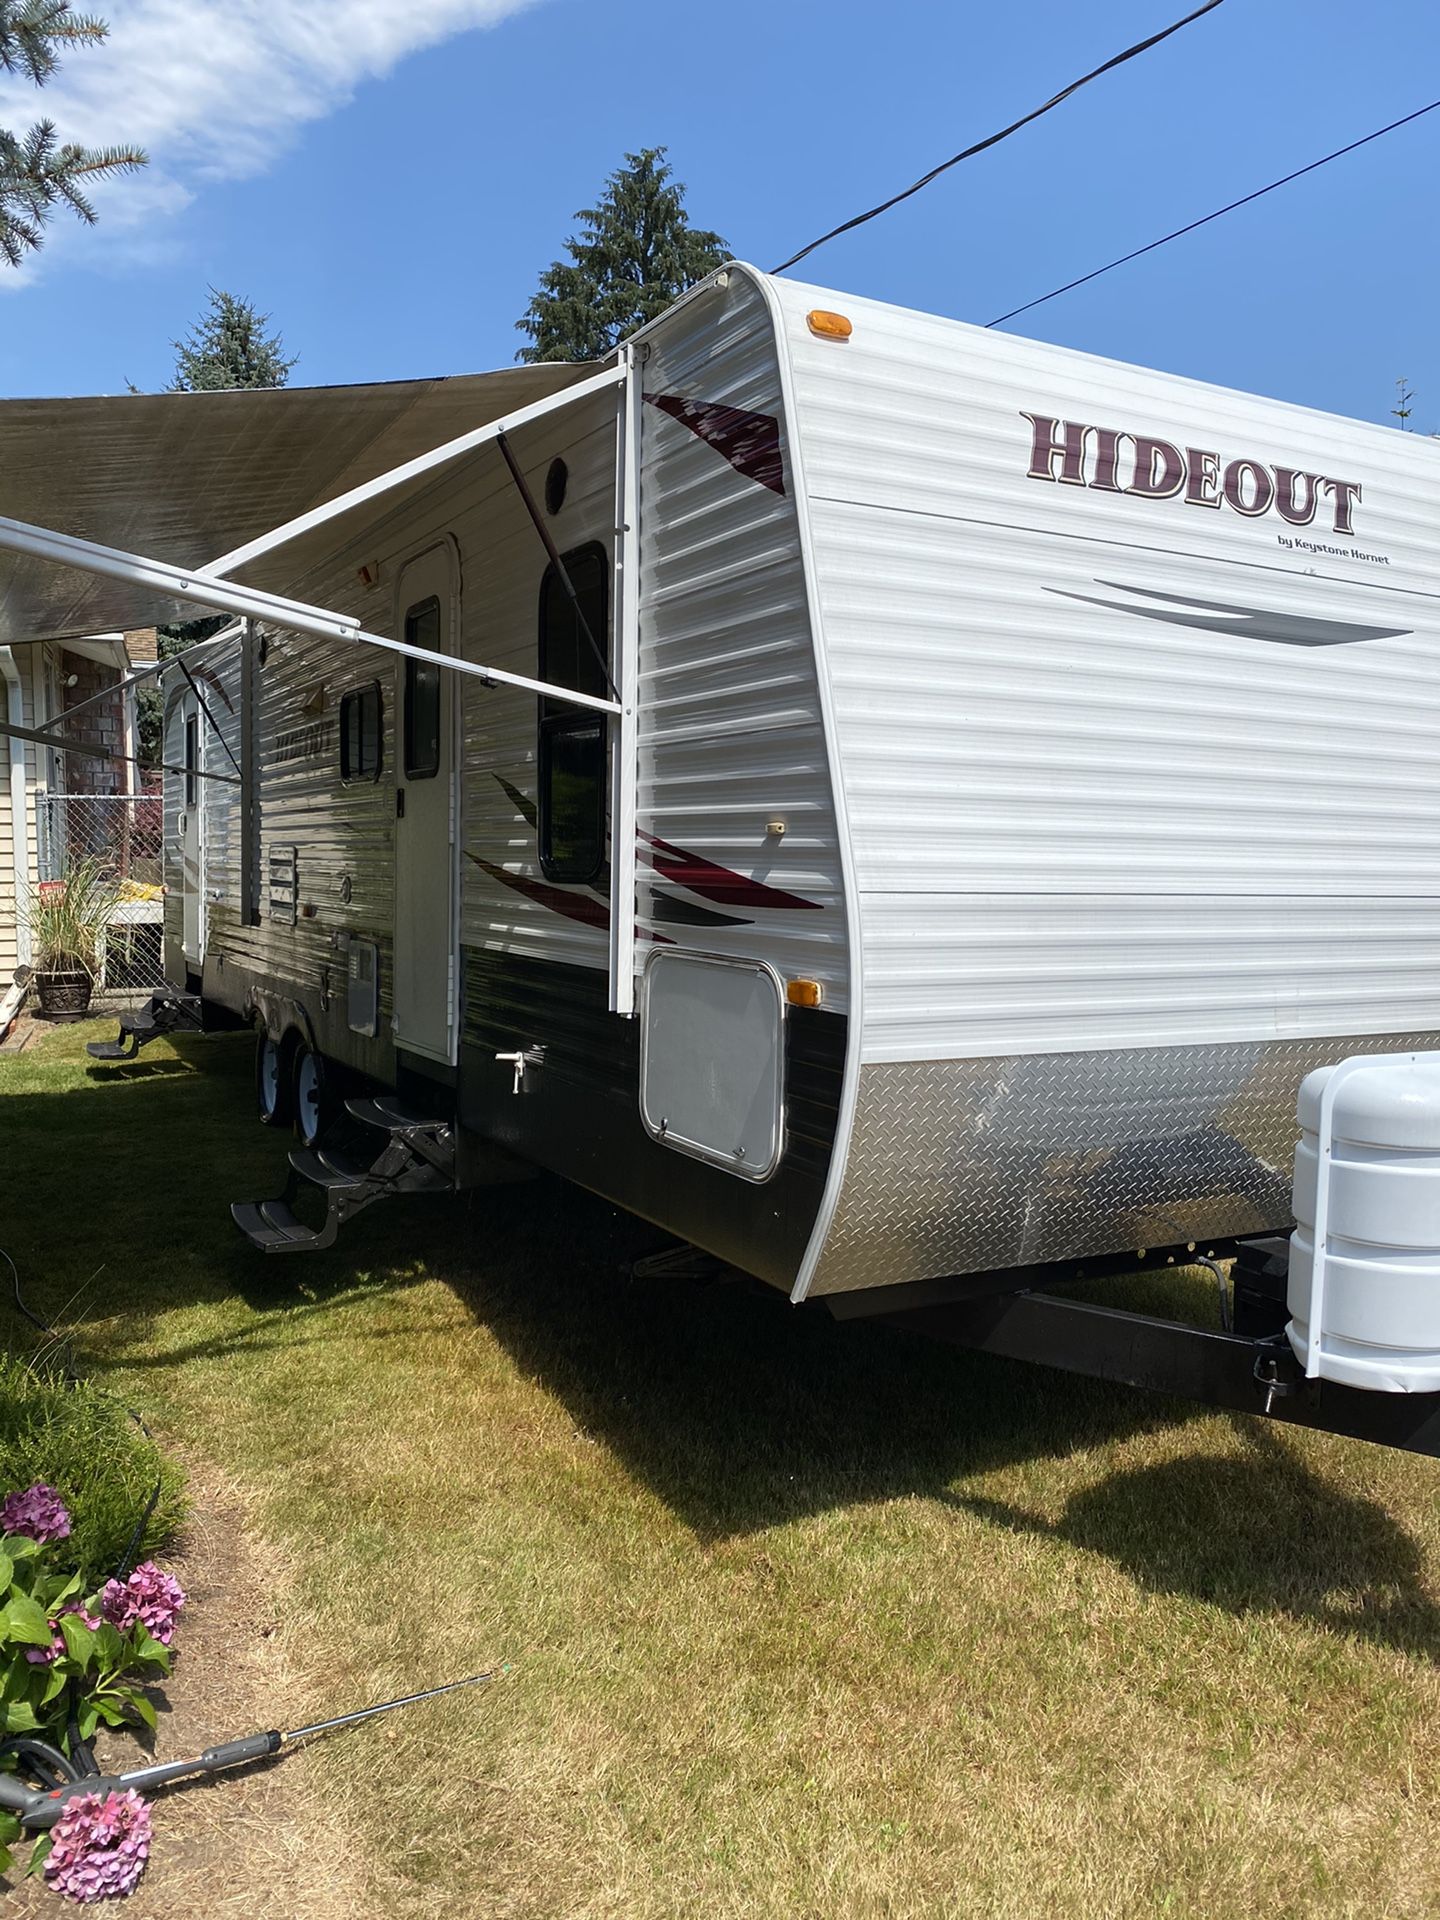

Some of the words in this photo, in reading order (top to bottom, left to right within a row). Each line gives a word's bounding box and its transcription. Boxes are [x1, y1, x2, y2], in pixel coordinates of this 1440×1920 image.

[1019, 411, 1362, 535] HIDEOUT
[1277, 535, 1293, 549] by
[1294, 538, 1350, 557] Keystone
[1351, 549, 1390, 565] Hornet
